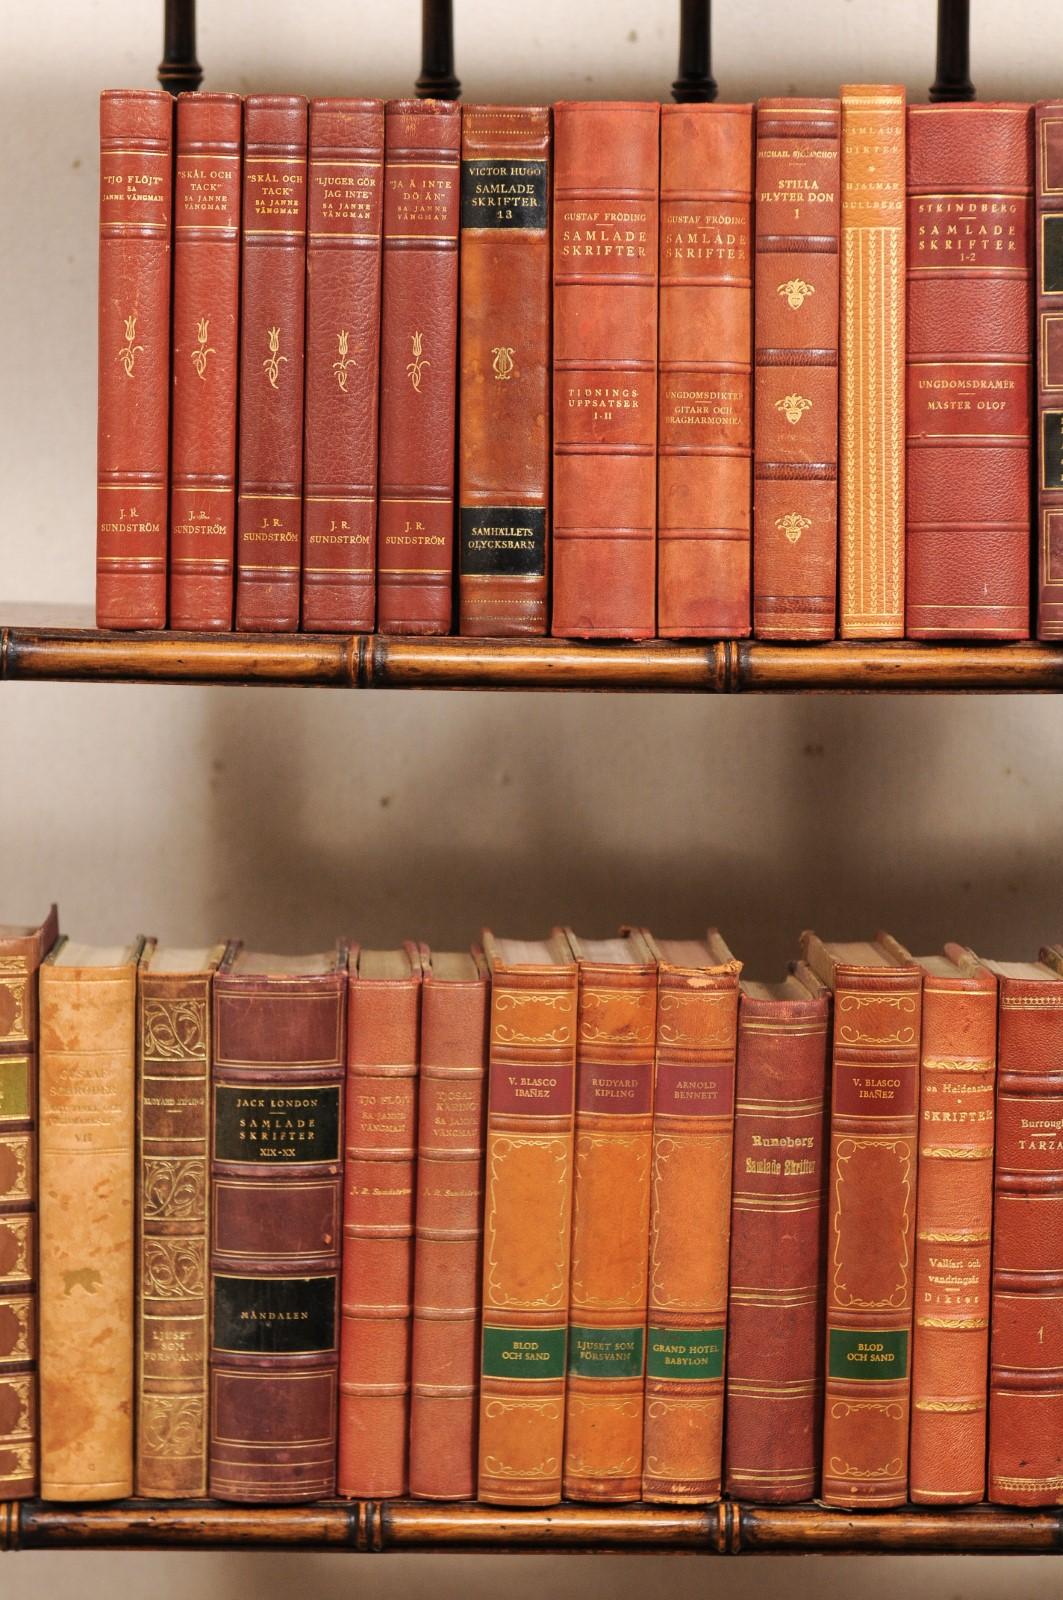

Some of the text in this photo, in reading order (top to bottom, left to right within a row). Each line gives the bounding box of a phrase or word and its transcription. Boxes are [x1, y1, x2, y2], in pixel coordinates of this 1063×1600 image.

[469, 167, 541, 176] VICTOR HUGO
[314, 177, 376, 187] "LJUGER GÖR
[778, 180, 819, 189] STILLA
[475, 184, 535, 193] SAMLADE
[324, 190, 372, 199] JAG INTE"
[404, 191, 419, 200] DÖ
[761, 193, 834, 202] FLYTER DON
[471, 197, 537, 207] SKRIFTER
[794, 208, 799, 219] 1
[918, 204, 1017, 213] STRINDBERG
[322, 211, 371, 219] VÄNGMAN
[496, 210, 513, 219] 13
[564, 212, 646, 222] GUSTAF FRÖDING
[667, 215, 746, 225] GUSTAF FRÖDING
[919, 225, 1016, 235] SAMLADE
[563, 231, 646, 241] SAMLADE
[666, 234, 746, 245] SAMLADE
[918, 240, 1016, 251] SKRIFTER
[563, 246, 646, 256] SKRIFTER
[666, 248, 746, 260] SKRIFTER
[960, 253, 976, 262] 1-2
[919, 379, 1015, 389] UNGDOMSDRAMER
[569, 400, 639, 408] UPPSATSER
[977, 401, 1006, 410] OLOF
[675, 406, 732, 414] GITARR OCH
[189, 511, 196, 520] J.
[101, 522, 160, 532] SUNDSTRÖM
[262, 518, 283, 528] J. R.
[330, 521, 350, 532] J. R.
[404, 521, 425, 533] J. R.
[174, 524, 227, 535] SUNDSTRÖM
[243, 532, 298, 542] SUNDSTRÖM
[310, 534, 370, 544] SUNDSTRÖM
[385, 535, 445, 545] SUNDSTRÖM
[468, 540, 535, 550] OLYCKSBARN
[520, 1078, 557, 1087] BLASCO
[592, 1078, 638, 1087] RUDYARD
[676, 1081, 716, 1089] ARNOLD
[853, 1078, 900, 1088] V. BLASCO
[515, 1088, 551, 1098] IBAÑEZ
[595, 1089, 635, 1098] KIPLING
[674, 1091, 718, 1100] BENNETT
[859, 1090, 894, 1099] IBAÑEZ
[236, 1099, 319, 1107] JACK LONDON
[924, 1110, 993, 1122] SKRIFTER
[240, 1119, 315, 1128] SAMLADE
[239, 1132, 315, 1140] SKRIFTER
[752, 1136, 814, 1148] Runeberg
[260, 1148, 296, 1157] XIX-XX
[745, 1157, 781, 1175] Samlade
[968, 1258, 981, 1268] och
[240, 1310, 309, 1320] MÅNDALEN
[1037, 1326, 1044, 1344] 1
[513, 1342, 539, 1350] BLOD
[577, 1340, 634, 1351] LJUSET SOM
[653, 1344, 719, 1354] GRAND HOTEL
[501, 1351, 551, 1361] OCH SAND
[664, 1356, 708, 1366] BABYLON
[847, 1353, 895, 1362] OCH SAND
